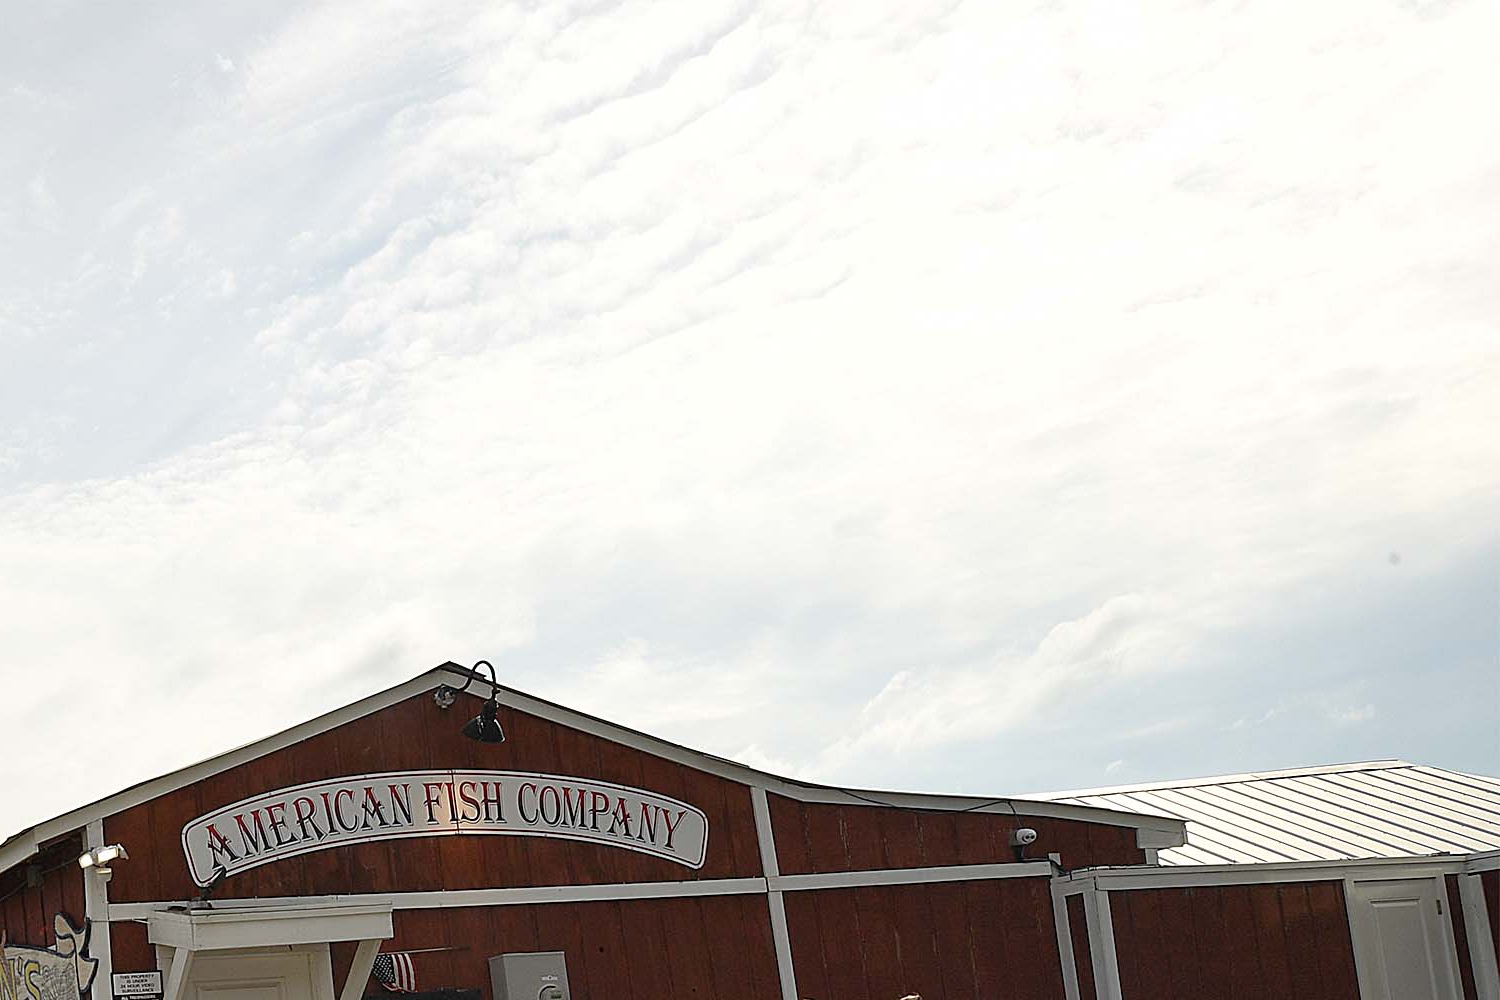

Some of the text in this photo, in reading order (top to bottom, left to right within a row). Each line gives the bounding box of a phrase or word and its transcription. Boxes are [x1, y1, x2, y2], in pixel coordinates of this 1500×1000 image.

[205, 781, 687, 871] AMERICAN FISH COMPANY
